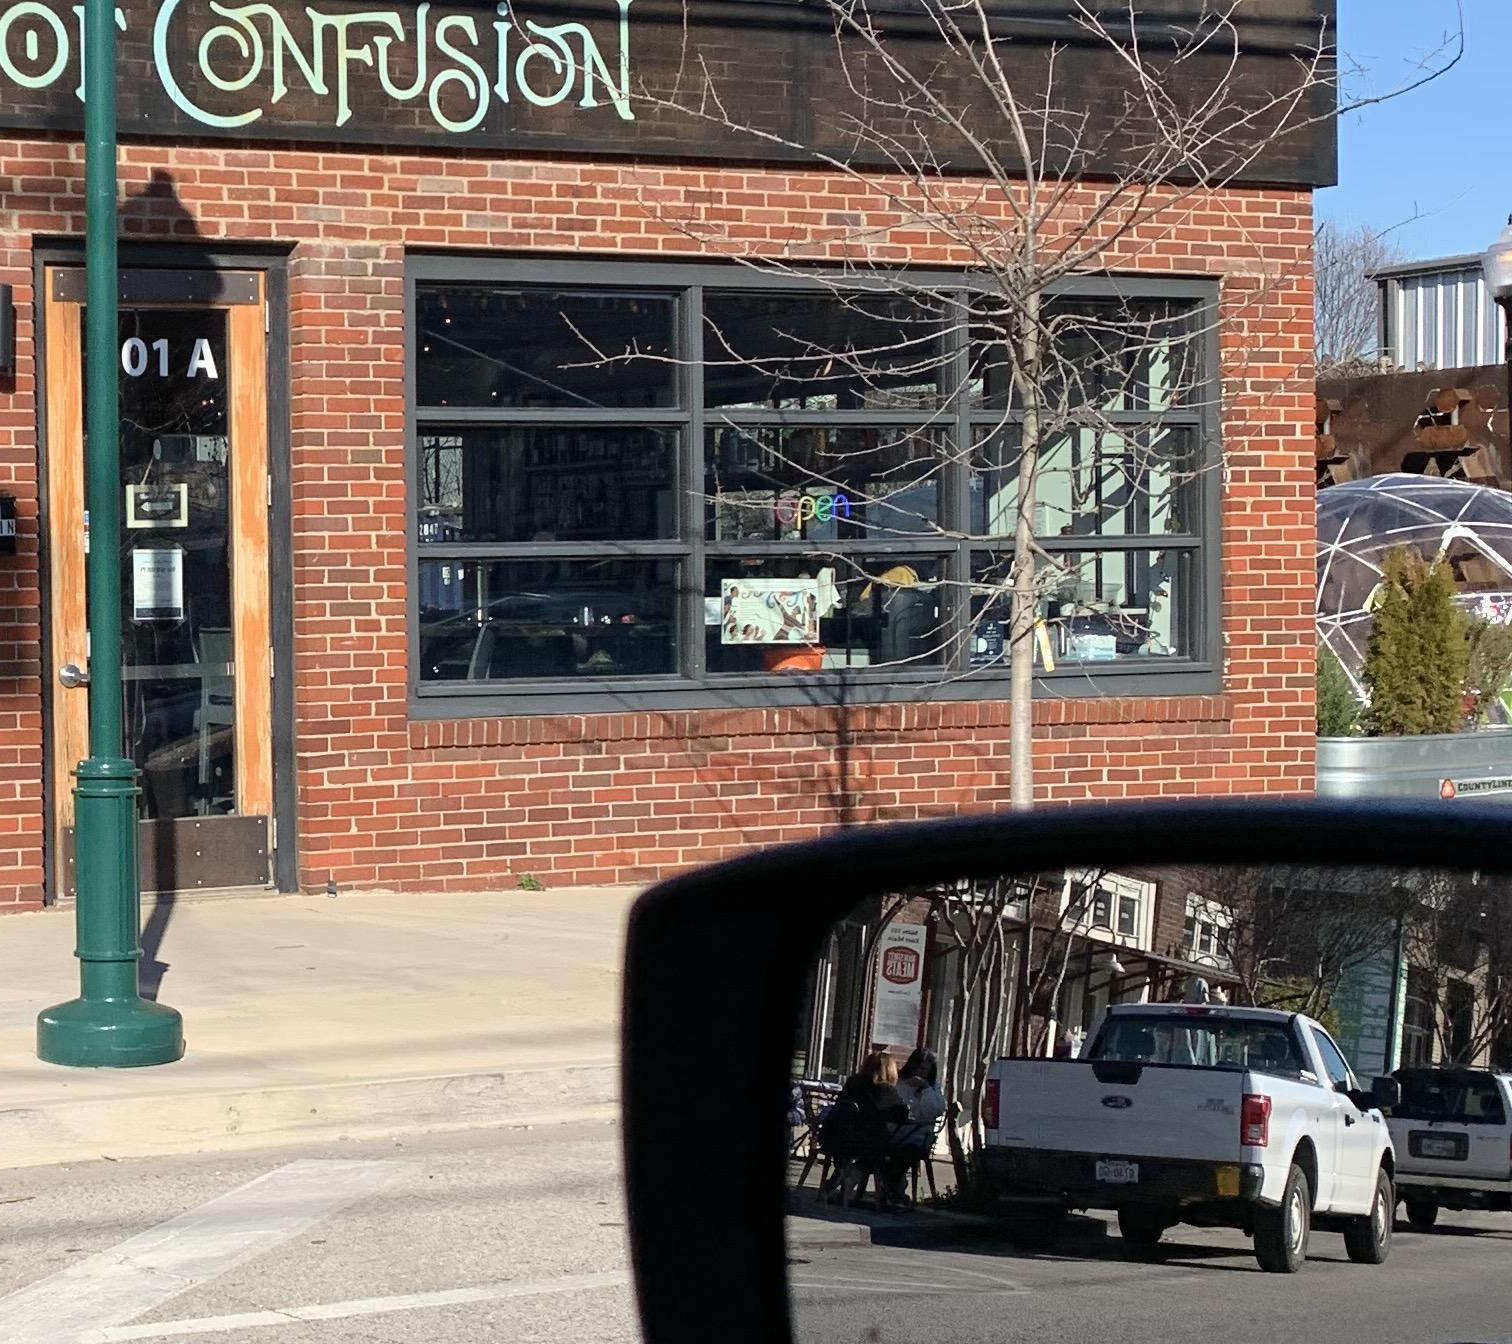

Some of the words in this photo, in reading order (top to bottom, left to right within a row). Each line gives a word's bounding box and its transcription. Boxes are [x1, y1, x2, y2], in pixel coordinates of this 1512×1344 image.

[120, 337, 169, 377] 01
[186, 338, 219, 378] A
[776, 494, 850, 530] open
